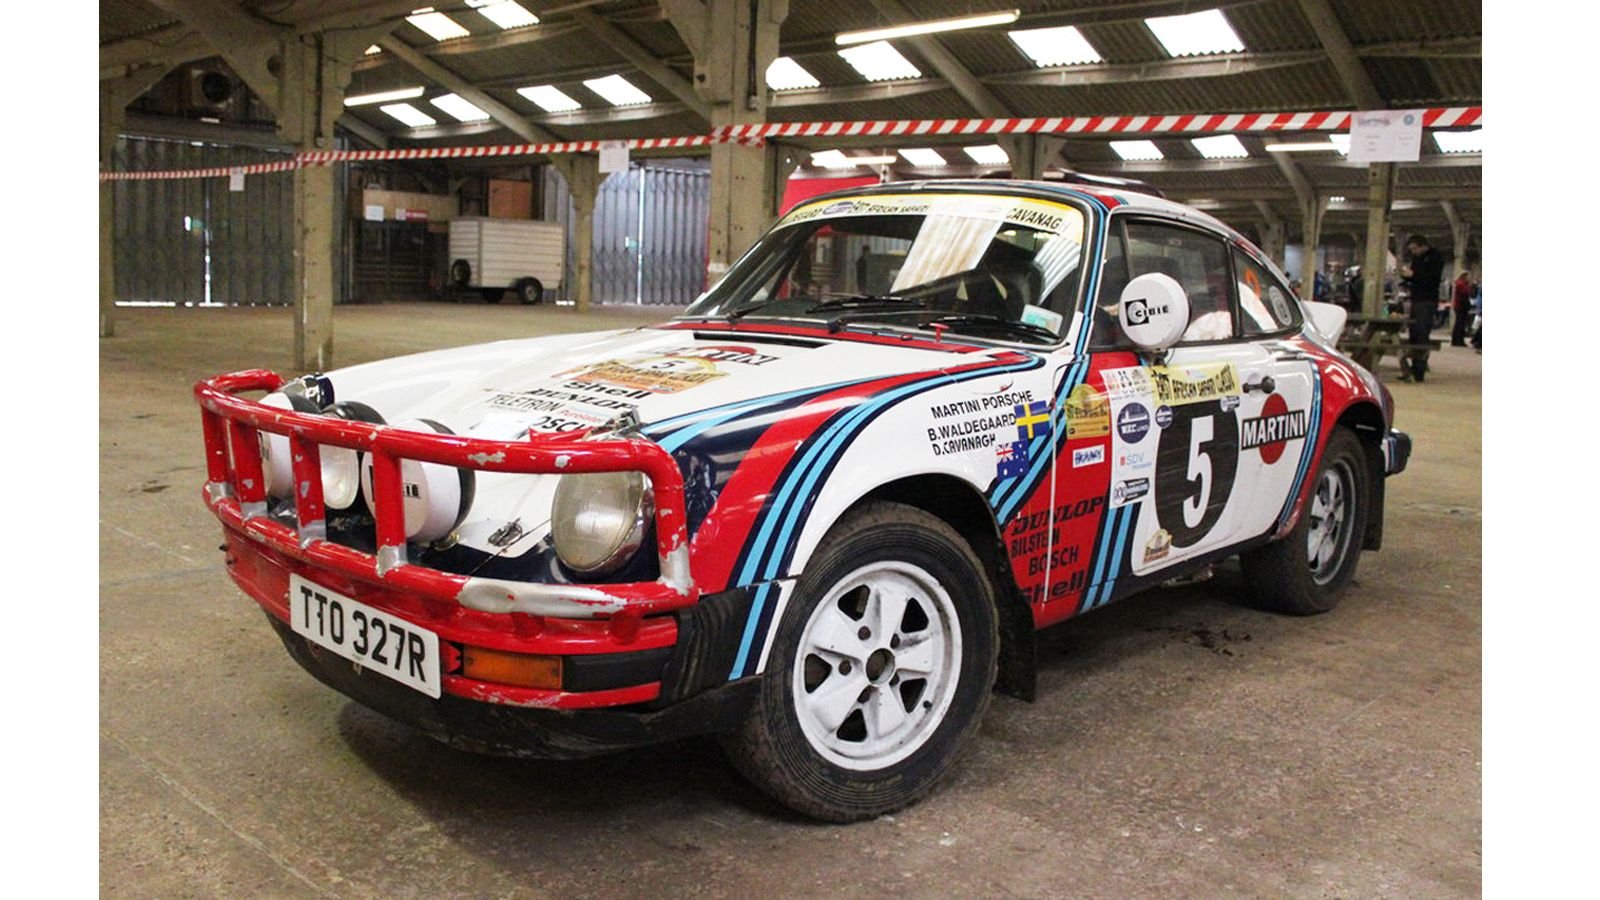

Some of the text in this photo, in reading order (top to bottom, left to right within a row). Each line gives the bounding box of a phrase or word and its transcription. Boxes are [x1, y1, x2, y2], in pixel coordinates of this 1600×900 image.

[486, 394, 565, 412] TELETRON
[525, 388, 639, 410] DUNLOP
[563, 381, 652, 399] Shell
[930, 390, 1034, 419] MARTINI PORSCHE
[533, 415, 586, 432] OSC
[927, 413, 1017, 441] B.WALDEGAARD
[1243, 412, 1304, 447] MARTINI
[932, 434, 997, 456] D.CAVANAGH
[1183, 415, 1214, 528] 5
[1011, 496, 1105, 536] DUNLOP
[1011, 529, 1060, 558] BILSTEIN
[1028, 546, 1080, 576] BOSCH
[300, 586, 426, 683] TTO 327R
